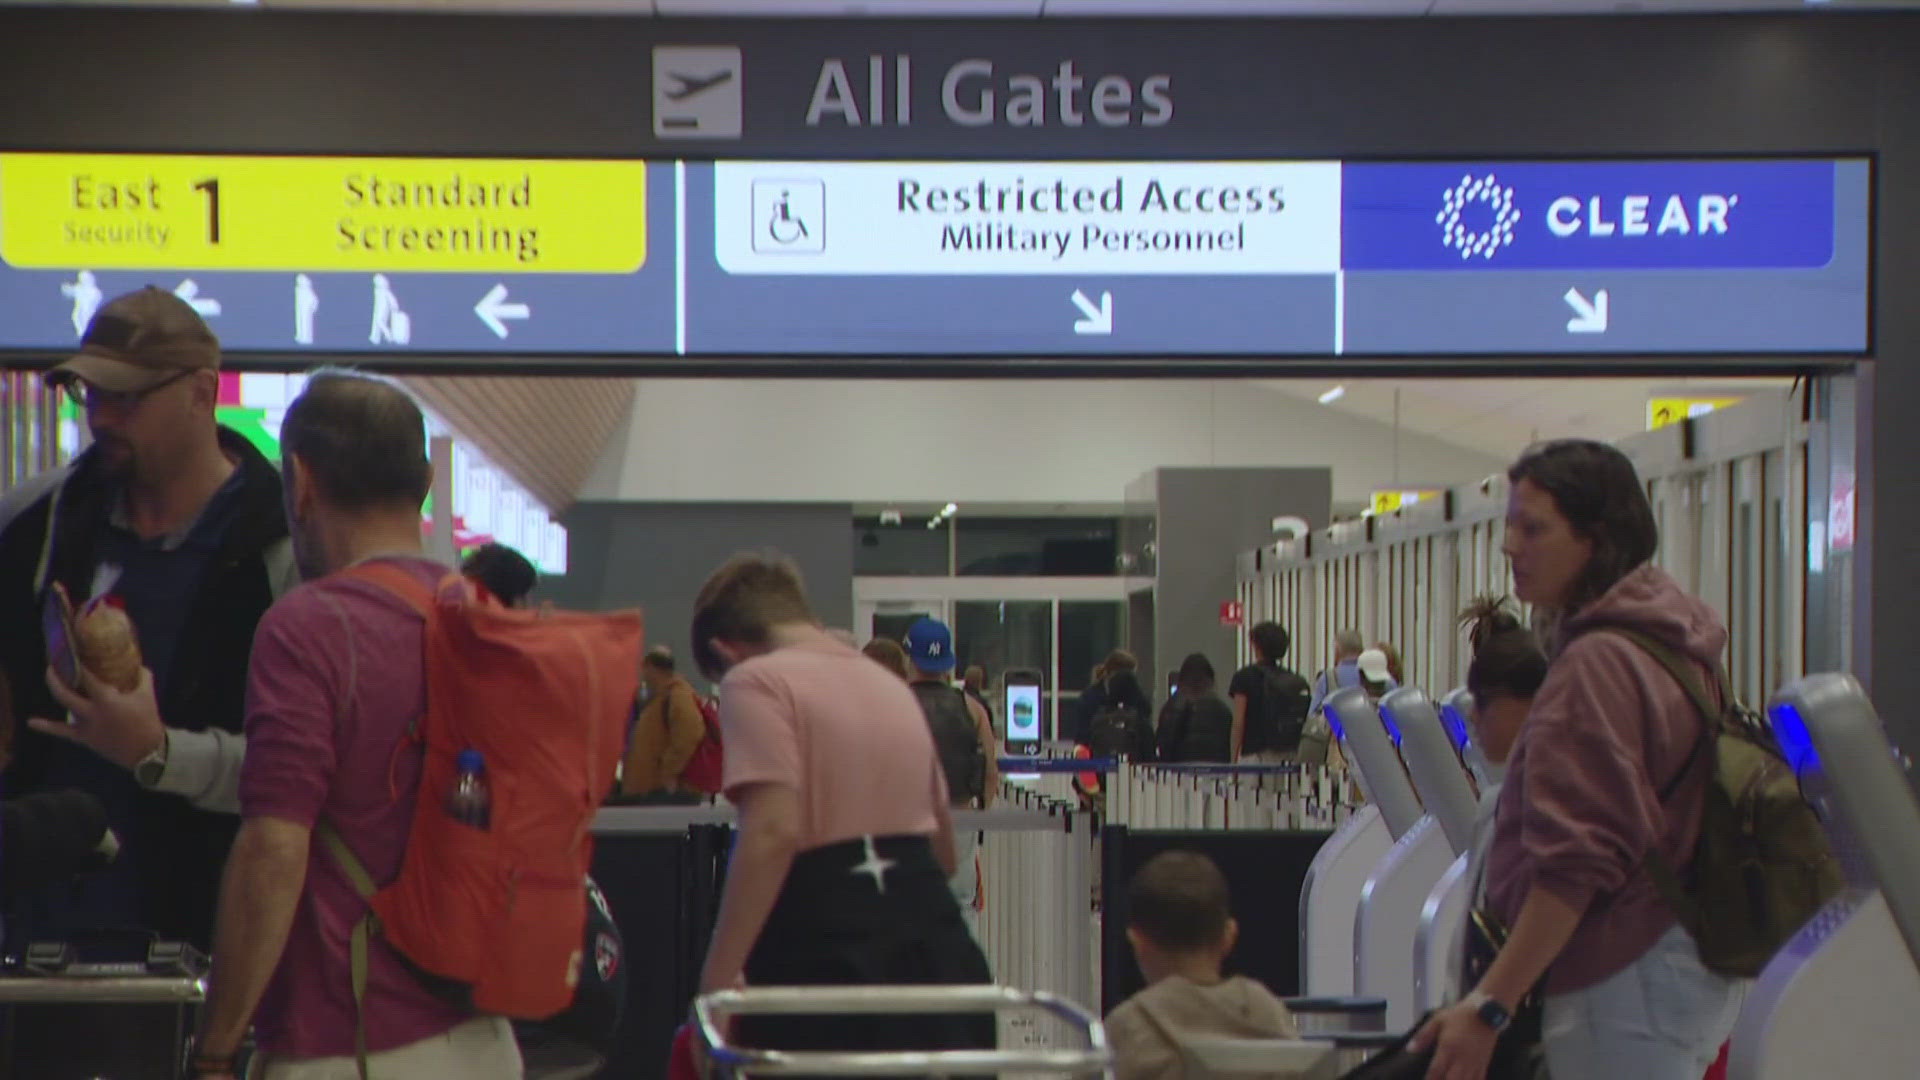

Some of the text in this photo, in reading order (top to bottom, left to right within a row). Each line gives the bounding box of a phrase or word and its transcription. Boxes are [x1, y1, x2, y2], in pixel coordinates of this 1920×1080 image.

[806, 53, 1175, 128] All Gates
[73, 174, 221, 245] East 1
[343, 173, 532, 208] Standard
[897, 177, 1285, 214] Restricted Access
[64, 219, 171, 248] Security
[1547, 195, 1730, 237] CLEAR
[336, 218, 540, 260] Screening
[941, 222, 1245, 260] Military Personnel
